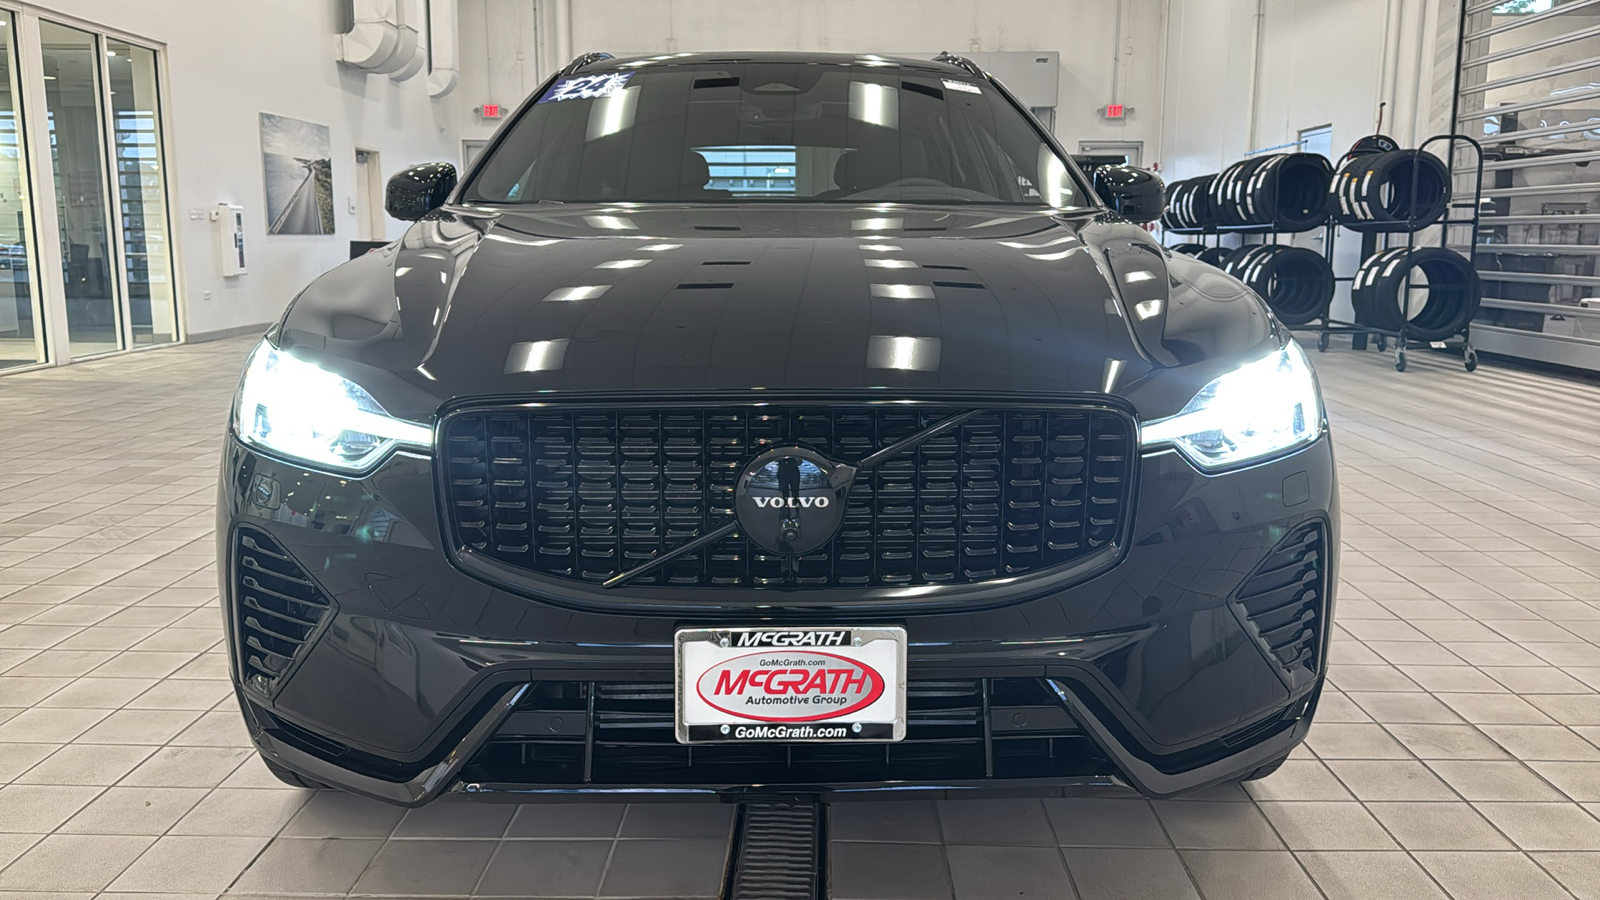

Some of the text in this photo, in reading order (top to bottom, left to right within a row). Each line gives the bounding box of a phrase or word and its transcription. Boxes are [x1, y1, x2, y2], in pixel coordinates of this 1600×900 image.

[563, 77, 612, 95] 24
[484, 105, 498, 117] EXIT
[1108, 105, 1122, 117] EXIT
[752, 496, 829, 509] VOLVO
[759, 658, 826, 667] GoMcGrath.com
[745, 695, 848, 706] Automotive Group
[735, 726, 847, 738] GoMcGrath.com
